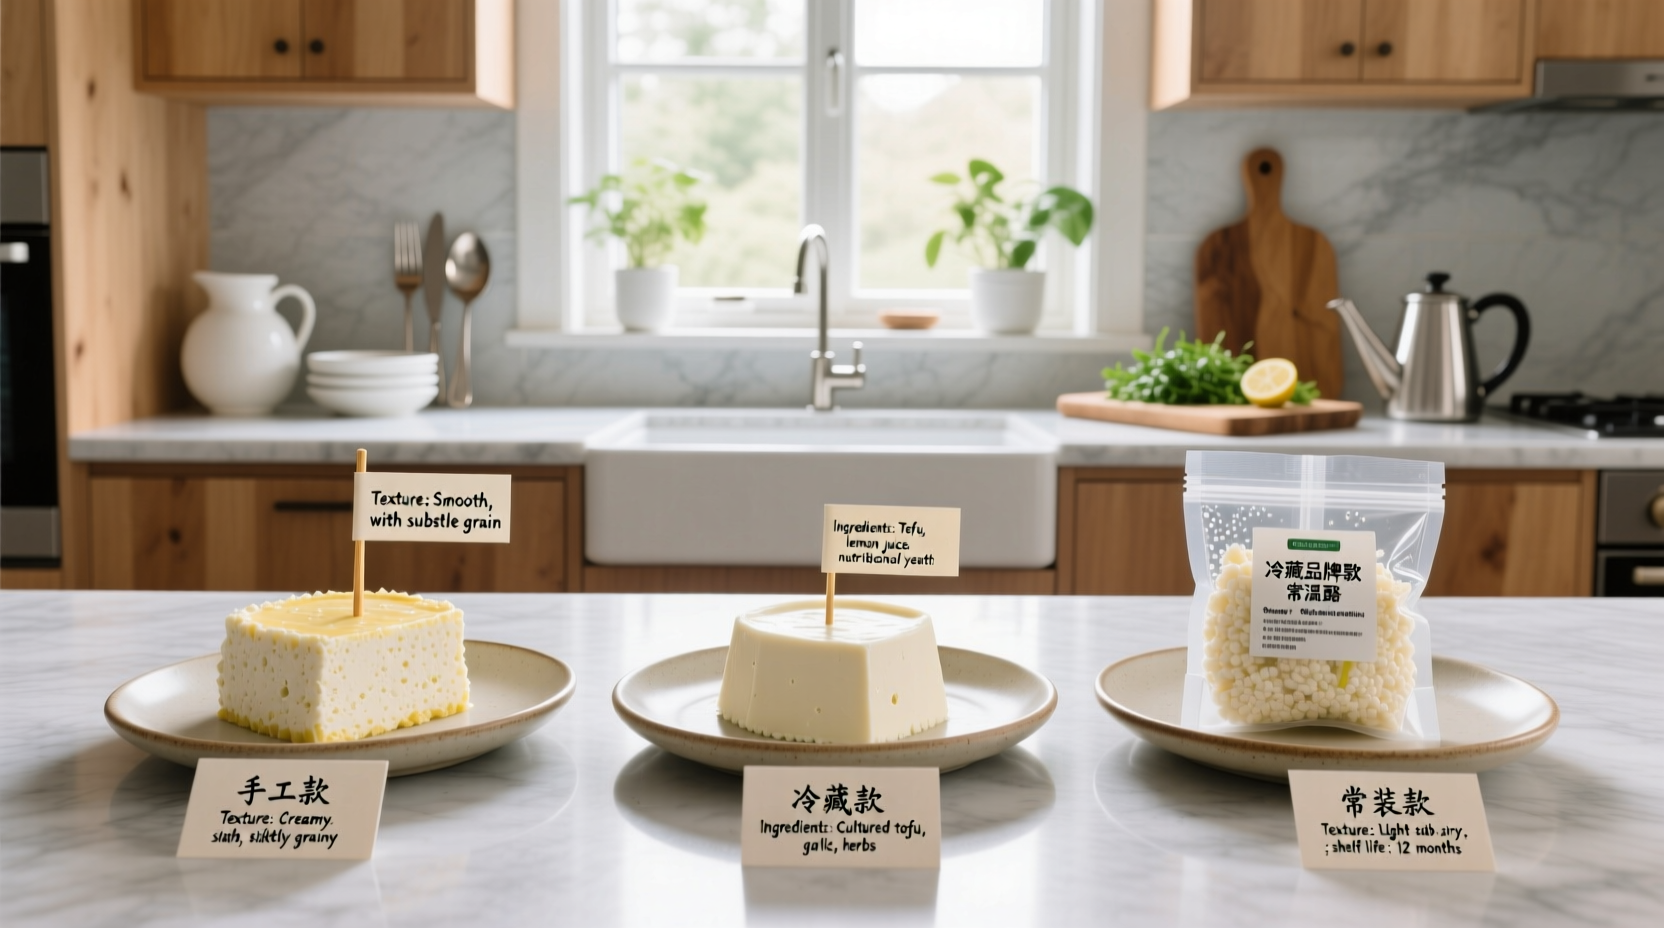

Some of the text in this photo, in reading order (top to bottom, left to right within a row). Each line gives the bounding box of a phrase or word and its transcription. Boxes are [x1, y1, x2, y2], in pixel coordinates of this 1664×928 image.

[371, 490, 493, 511] Texture: Smooth,
[370, 511, 402, 527] with
[463, 514, 501, 534] grain
[846, 535, 879, 549] lemon
[237, 775, 330, 806] 手工款
[791, 783, 885, 816] 冷藏款
[1341, 785, 1436, 818] 常装款
[220, 810, 274, 825] Texture:
[837, 820, 890, 834] Cultured
[894, 820, 926, 839] tofu,
[1320, 823, 1375, 836] Texture:
[294, 832, 338, 850] grainy
[843, 837, 877, 852] herbs
[1397, 841, 1411, 855] 12
[1416, 840, 1462, 854] months
